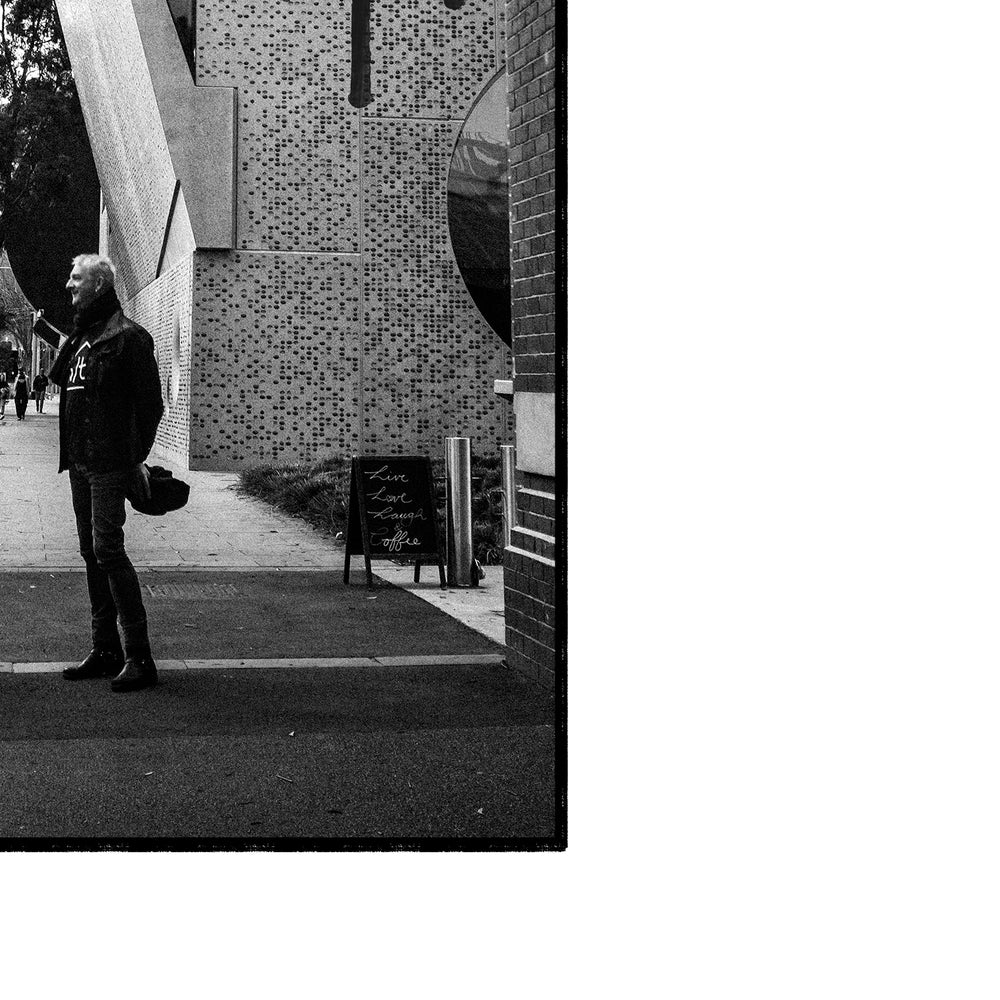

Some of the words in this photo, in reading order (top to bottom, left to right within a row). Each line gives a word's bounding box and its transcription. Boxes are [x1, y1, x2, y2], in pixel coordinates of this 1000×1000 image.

[364, 465, 409, 482] Live
[366, 486, 413, 503] Love
[367, 506, 427, 527] Laugh
[370, 526, 421, 552] Coffee
